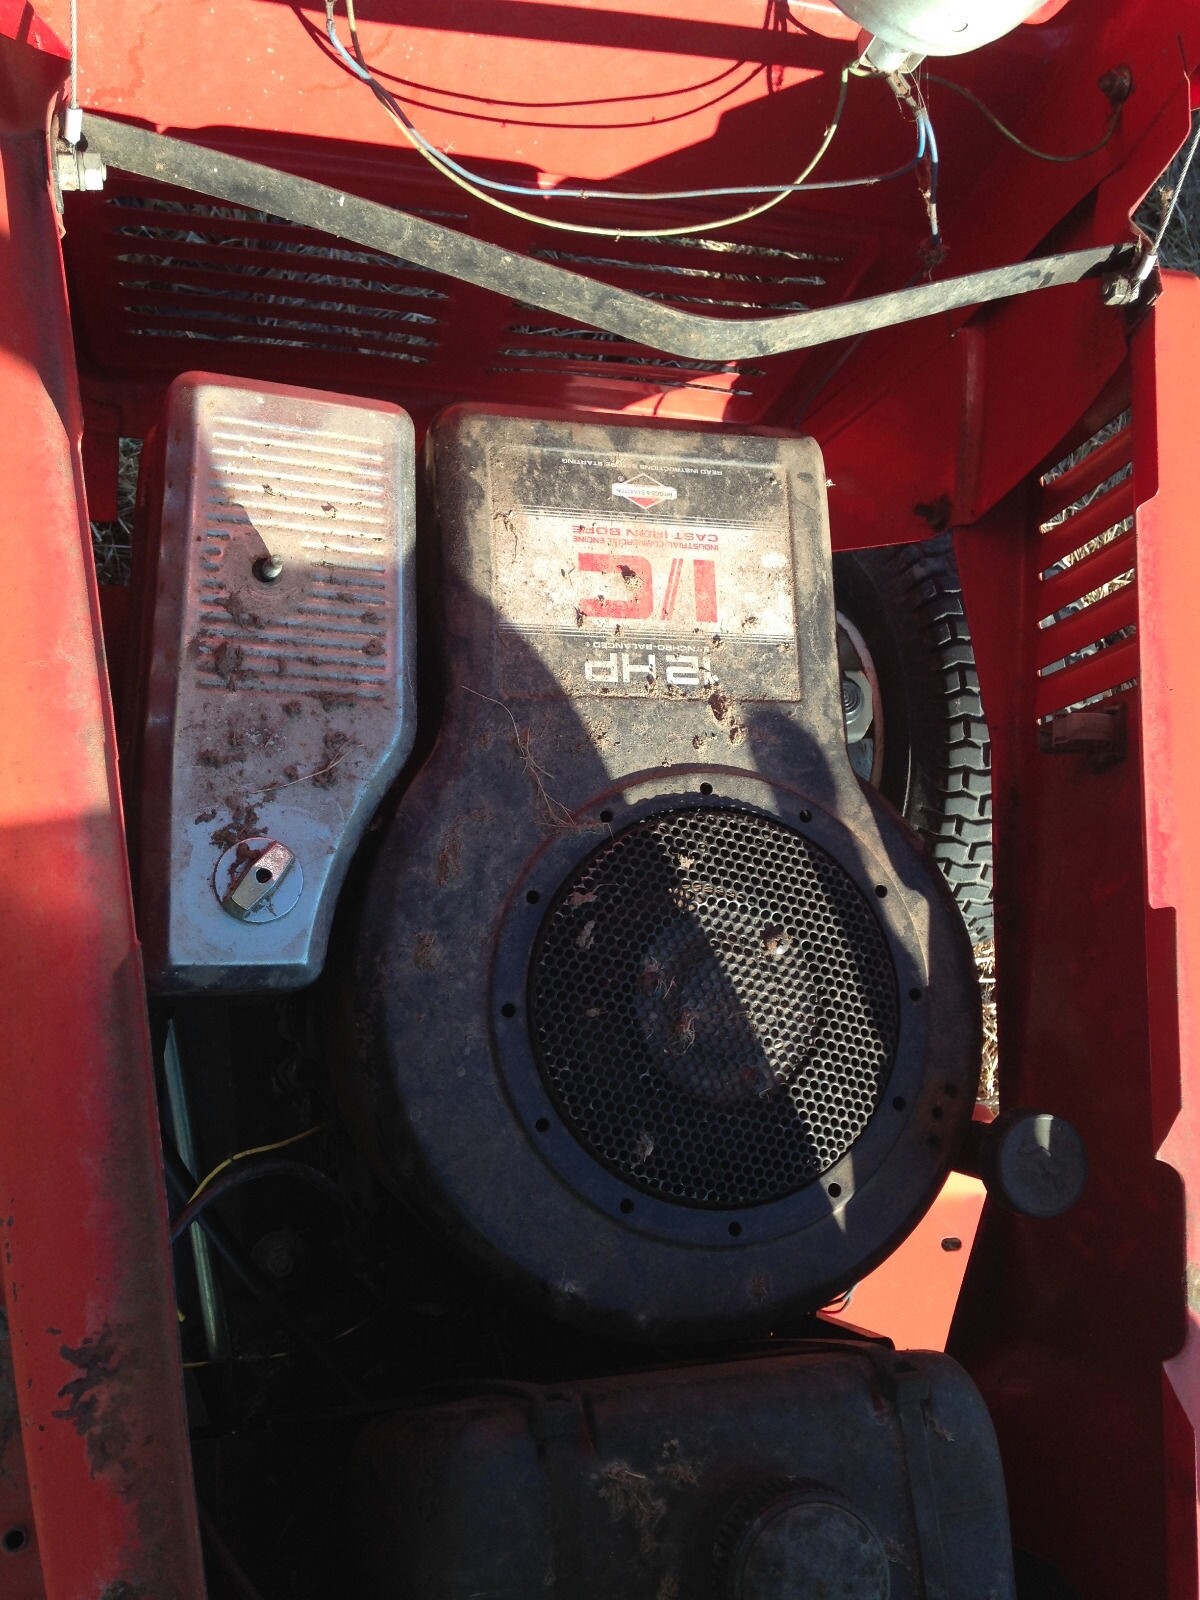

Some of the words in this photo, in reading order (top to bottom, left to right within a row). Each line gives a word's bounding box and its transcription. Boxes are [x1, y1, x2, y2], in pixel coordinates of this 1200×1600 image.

[561, 458, 603, 466] STARTING
[639, 464, 699, 474] INSTRUCTIONS
[571, 525, 621, 536] BORE
[626, 528, 668, 539] IRON
[572, 535, 605, 544] ENGINE
[672, 532, 719, 542] CAST
[584, 653, 656, 683] HP
